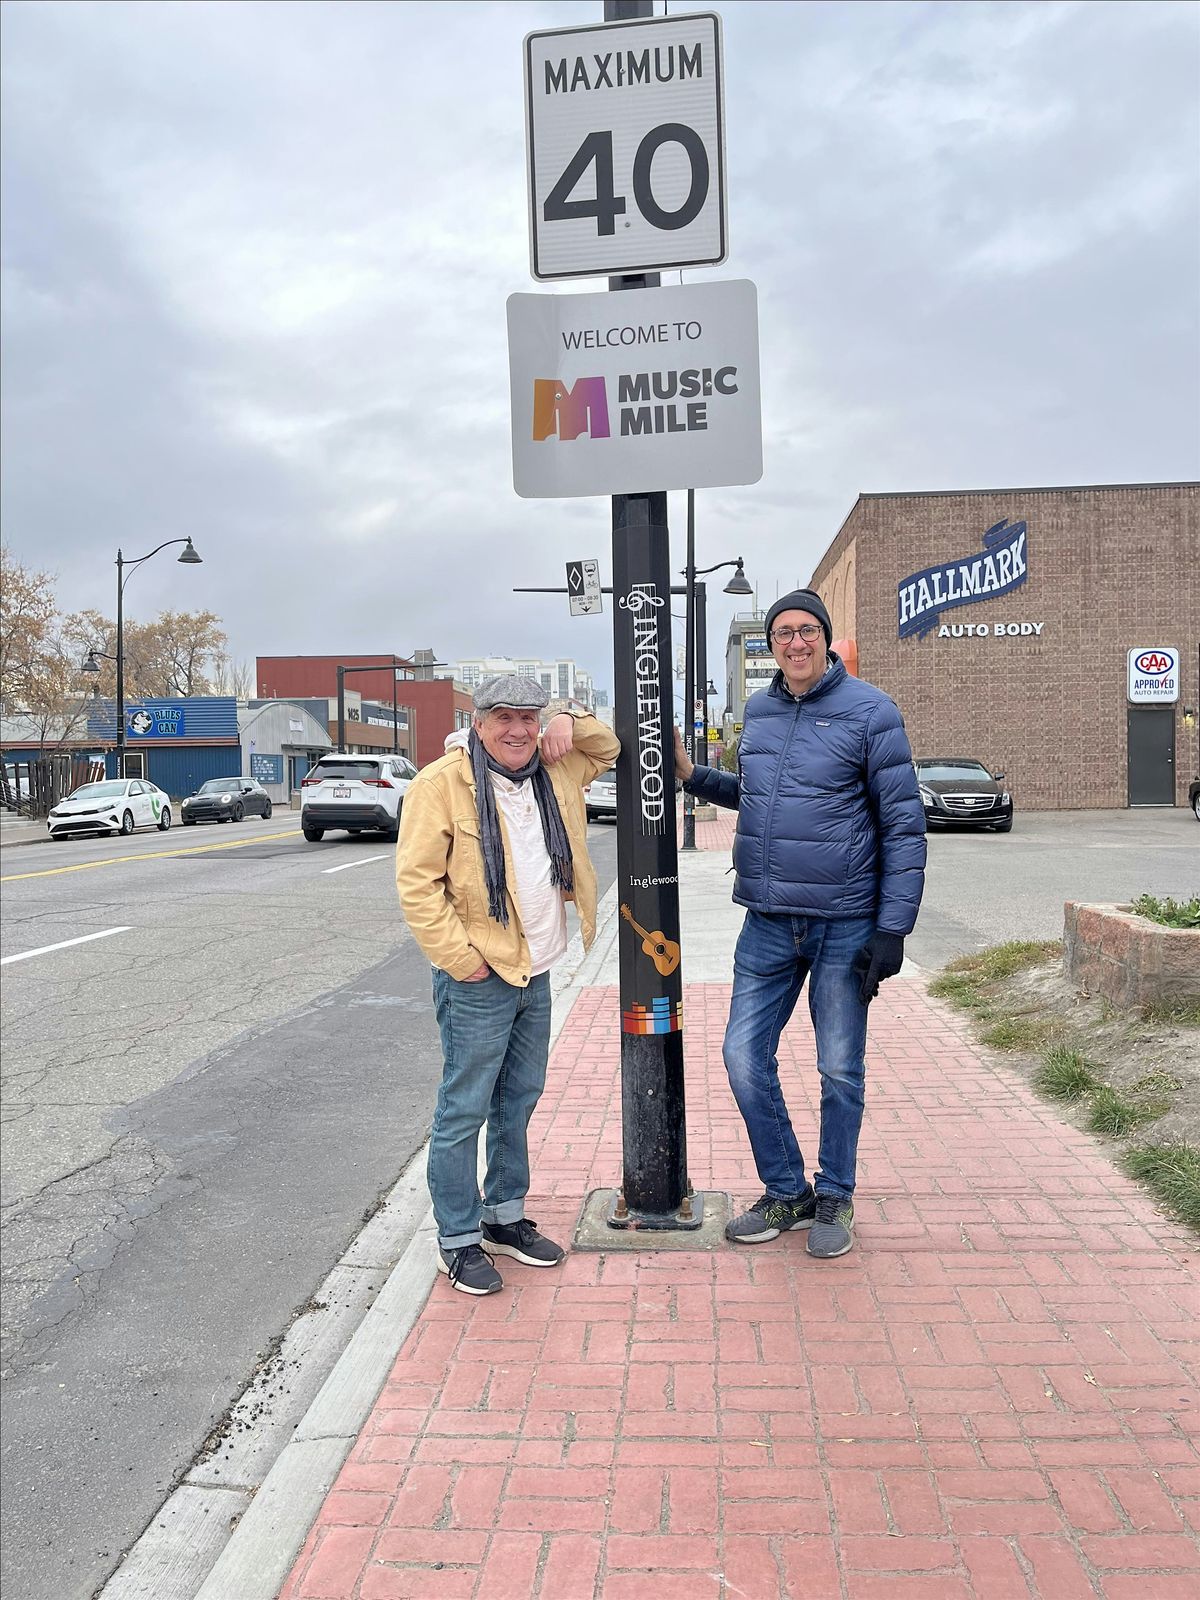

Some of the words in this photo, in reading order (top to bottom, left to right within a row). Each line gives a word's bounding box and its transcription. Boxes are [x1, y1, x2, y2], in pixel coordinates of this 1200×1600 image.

[544, 43, 702, 94] MAXIMUM
[543, 122, 709, 236] 40
[562, 324, 668, 350] WELCOME
[672, 321, 702, 341] TO
[618, 366, 739, 403] MUSIC
[620, 402, 708, 436] MILE
[899, 532, 1026, 625] HALLMARK
[938, 624, 989, 637] AUTO
[994, 622, 1045, 636] BODY
[1140, 654, 1168, 671] CAA
[1134, 678, 1174, 689] APPROVED
[154, 709, 181, 721] BLUES
[158, 722, 178, 734] CAN
[634, 616, 664, 822] INGLEWOOD
